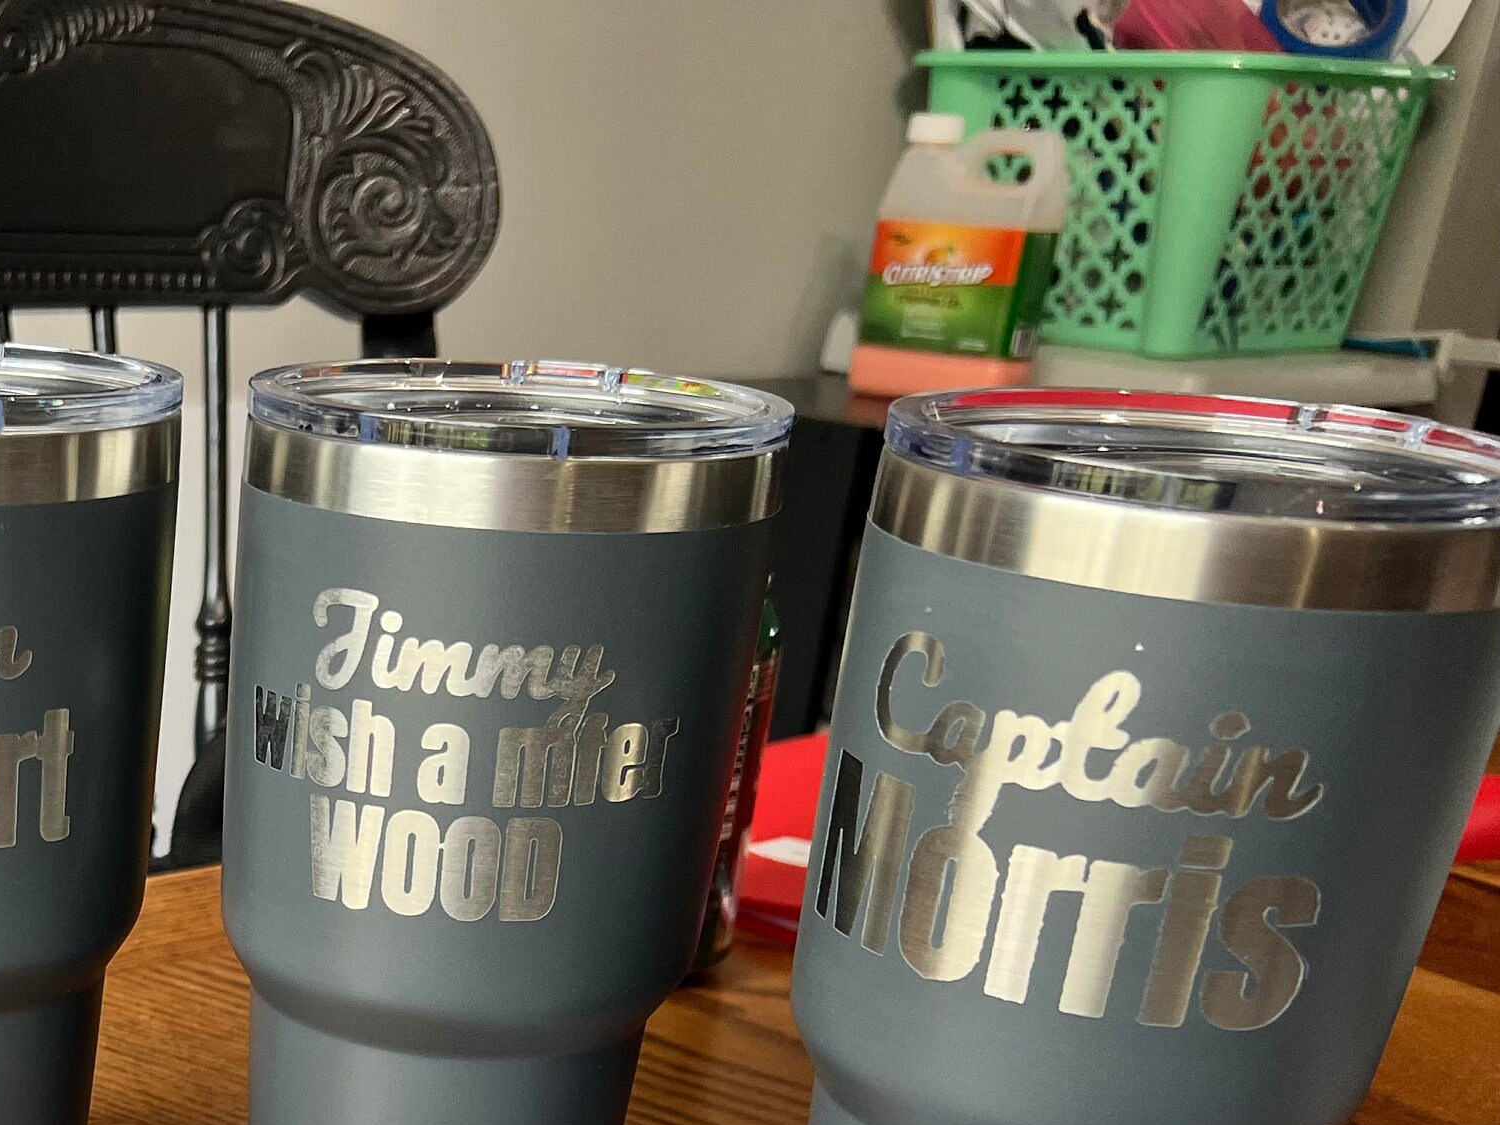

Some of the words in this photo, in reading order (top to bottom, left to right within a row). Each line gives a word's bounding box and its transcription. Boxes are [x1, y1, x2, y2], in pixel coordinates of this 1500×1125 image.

[312, 587, 616, 740] Jimmy
[874, 631, 1325, 836] Captain
[253, 682, 396, 798] wish
[416, 723, 470, 805] a
[309, 793, 564, 922] WOOD
[814, 748, 1323, 1031] Morris
